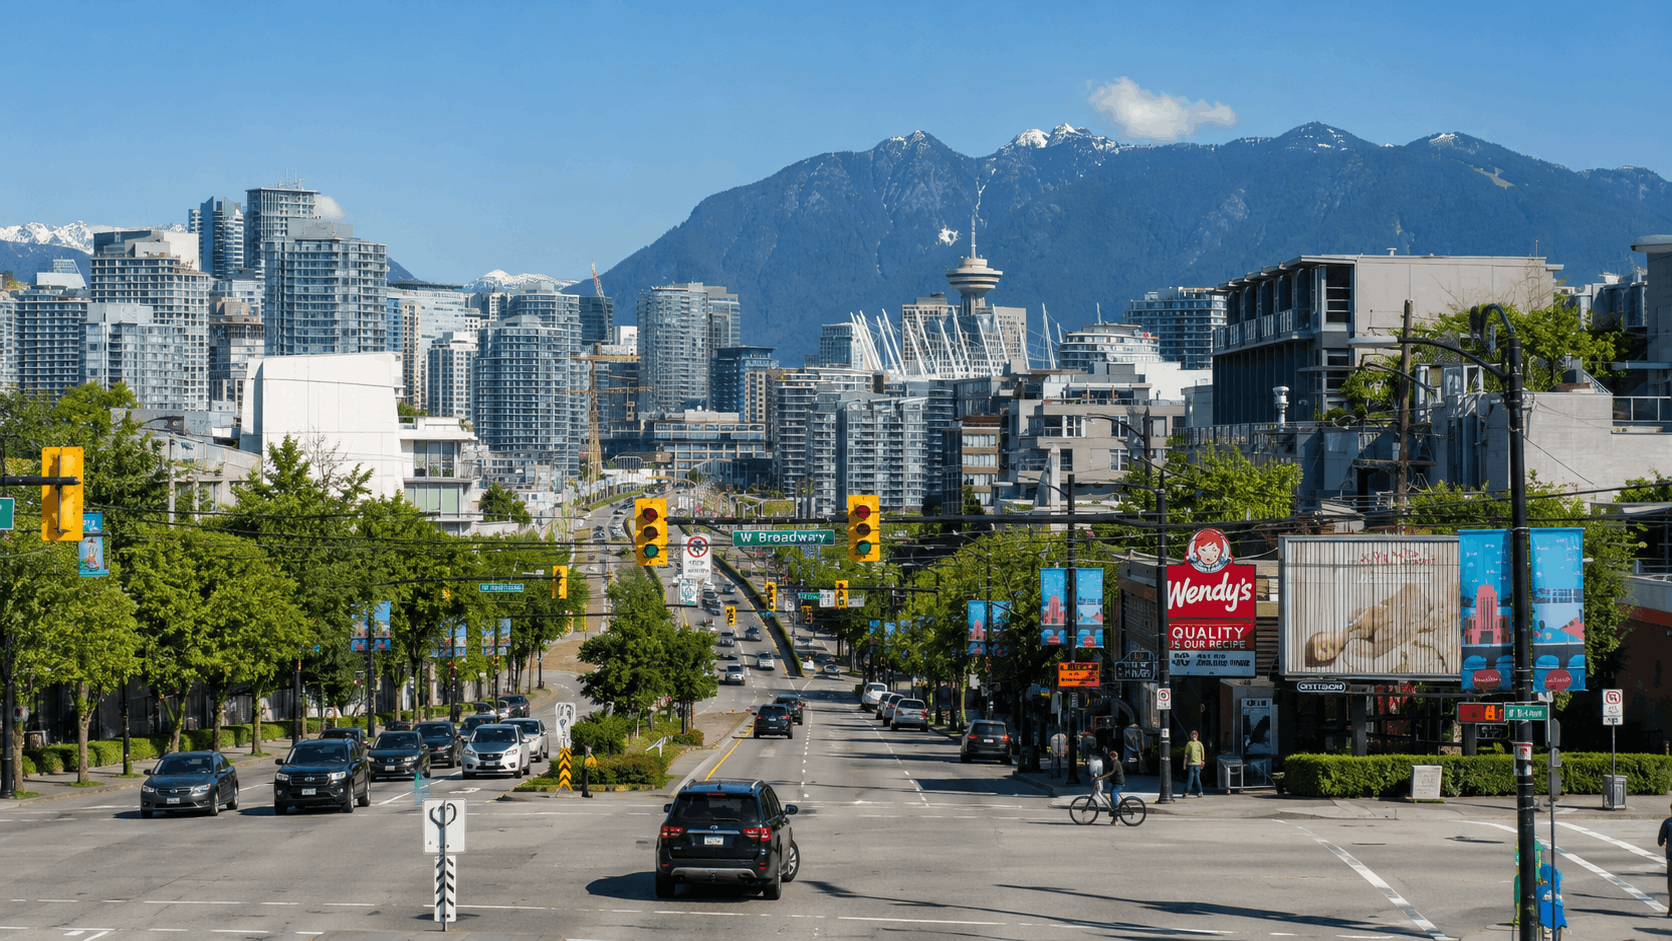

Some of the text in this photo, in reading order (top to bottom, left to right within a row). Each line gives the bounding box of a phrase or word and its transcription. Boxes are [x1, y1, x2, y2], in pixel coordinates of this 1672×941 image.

[740, 530, 826, 543] W Broadway
[1167, 572, 1252, 612] Wendy's
[1172, 626, 1244, 639] QUALITY
[1184, 640, 1205, 648] OUR
[1209, 640, 1246, 649] RECIPE
